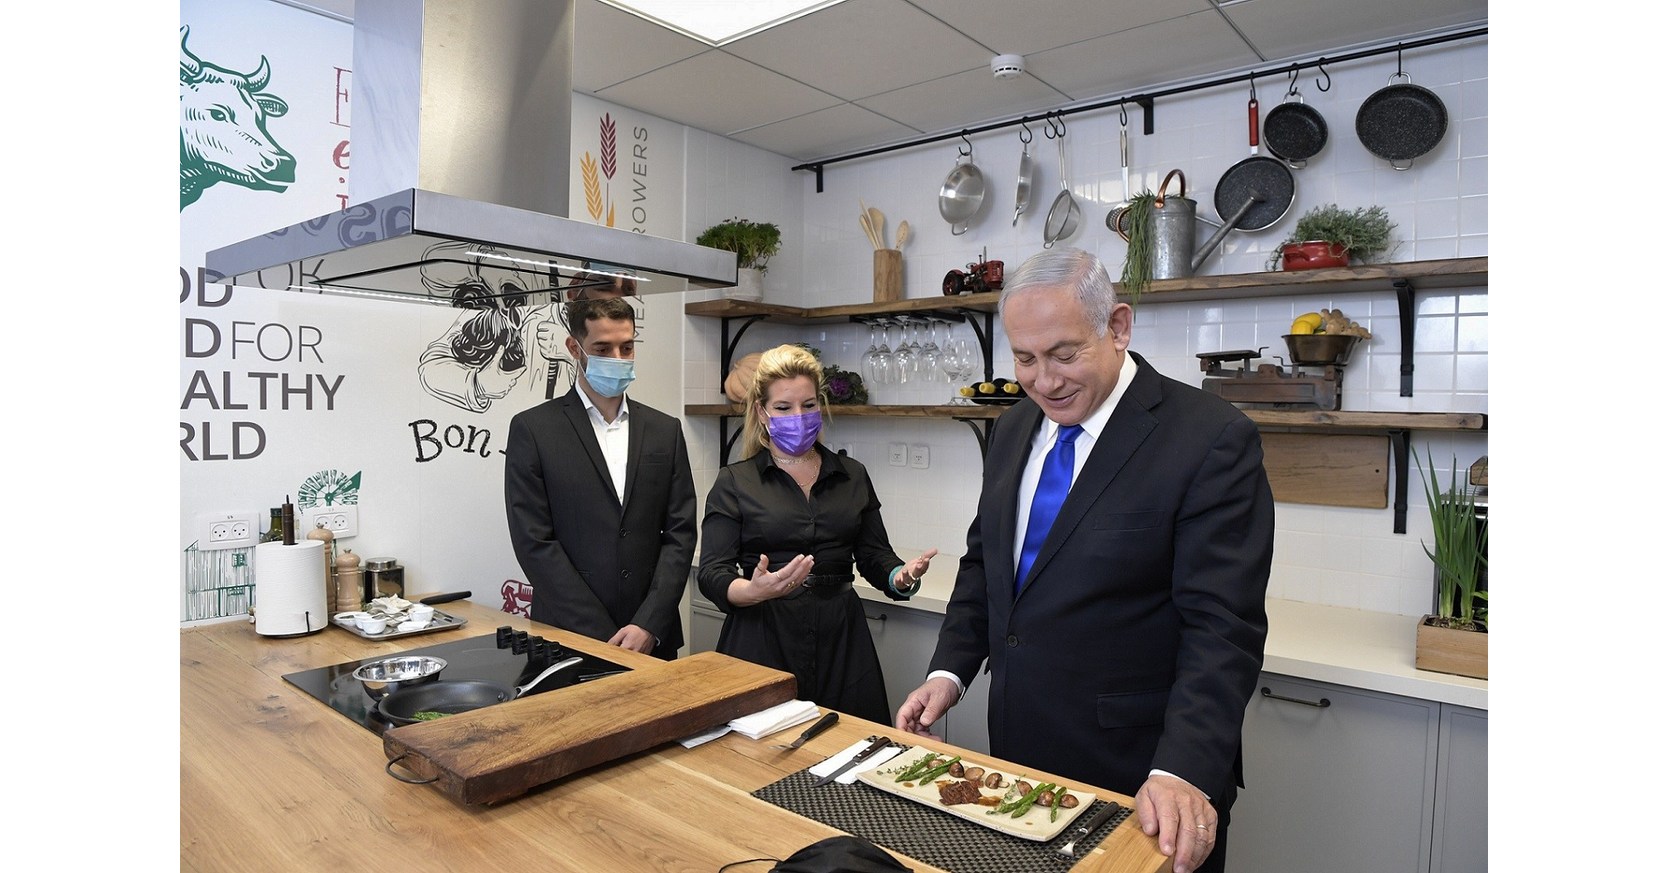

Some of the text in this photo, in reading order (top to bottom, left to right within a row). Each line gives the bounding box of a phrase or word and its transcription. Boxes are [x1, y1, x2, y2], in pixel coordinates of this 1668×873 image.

[232, 320, 324, 363] FOR
[180, 369, 346, 411] ALTHY
[408, 419, 491, 463] Bon
